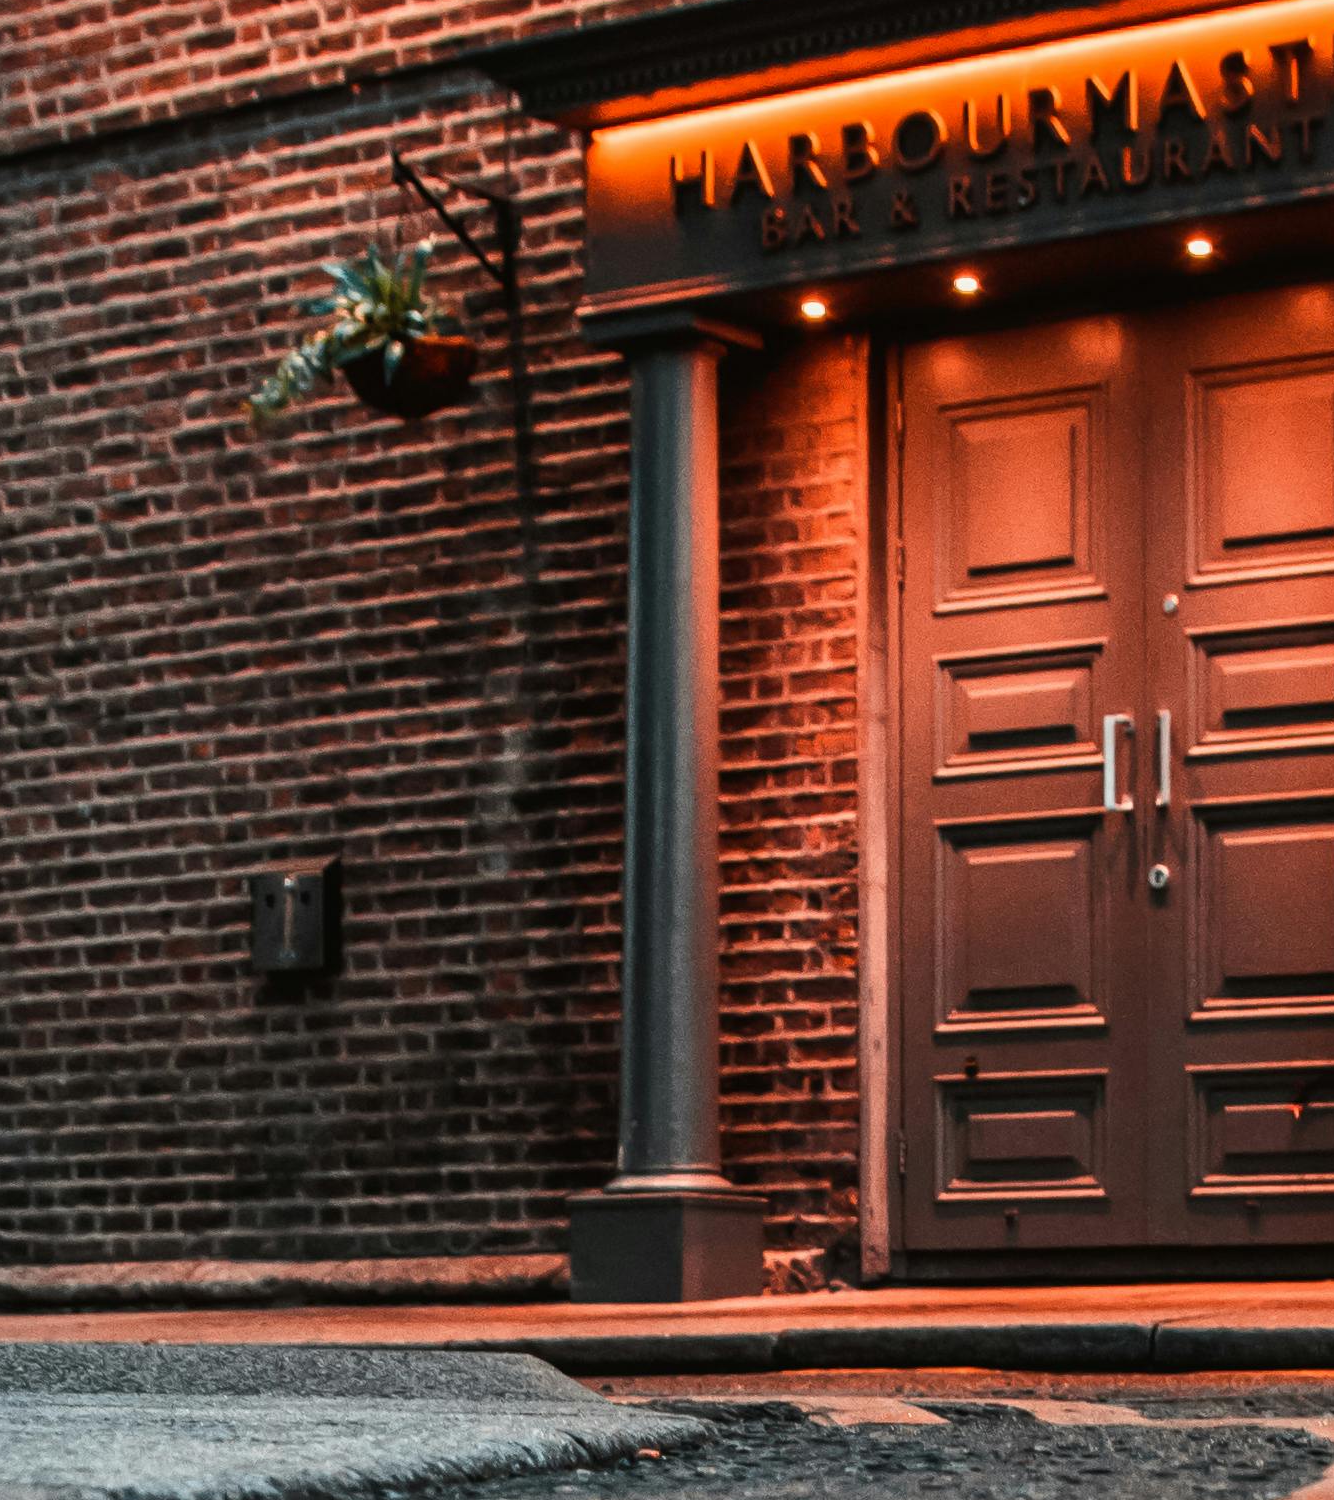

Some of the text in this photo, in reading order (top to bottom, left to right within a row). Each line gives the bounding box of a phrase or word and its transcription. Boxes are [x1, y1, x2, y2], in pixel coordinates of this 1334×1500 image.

[760, 116, 1326, 251] BAR & RESTAURANT
